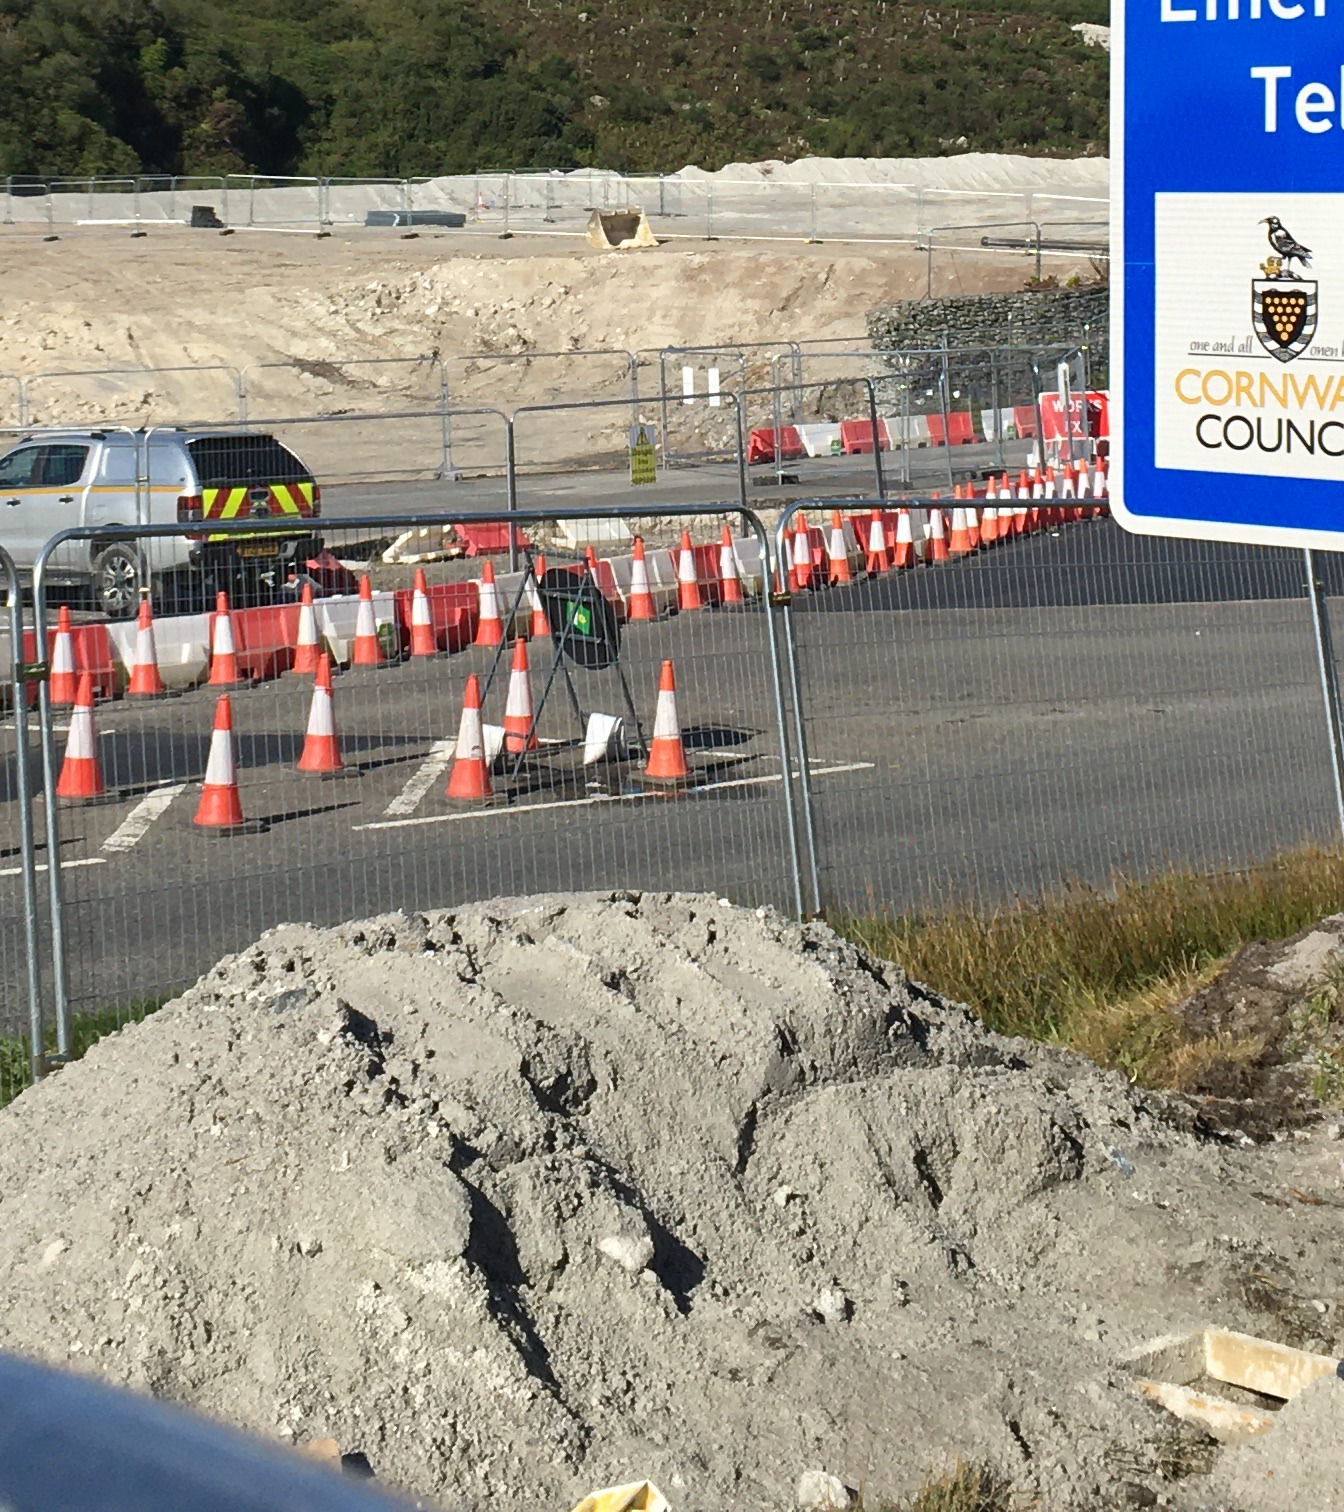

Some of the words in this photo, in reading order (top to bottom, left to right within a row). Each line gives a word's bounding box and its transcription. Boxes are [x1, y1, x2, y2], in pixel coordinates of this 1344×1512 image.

[1189, 341, 1210, 352] one
[1212, 337, 1235, 354] and
[1237, 335, 1253, 354] all
